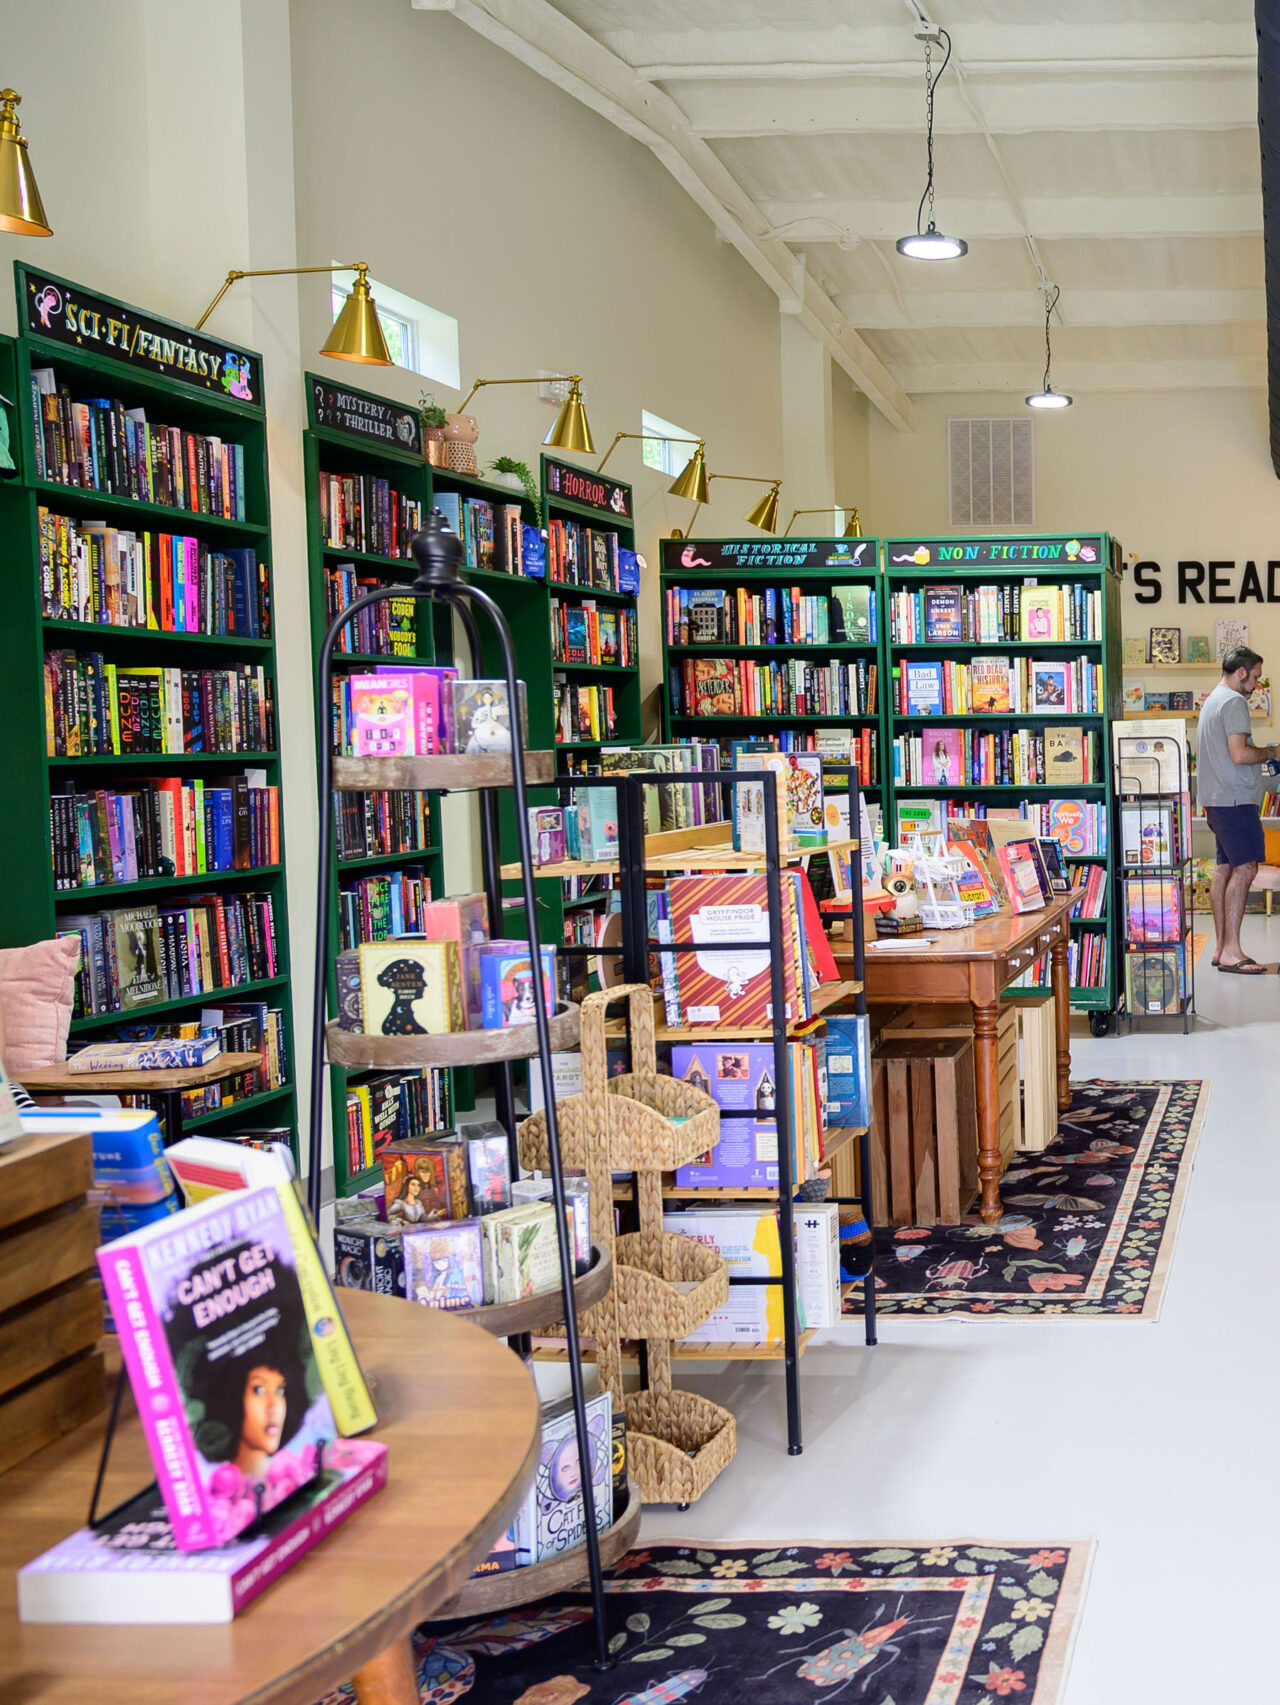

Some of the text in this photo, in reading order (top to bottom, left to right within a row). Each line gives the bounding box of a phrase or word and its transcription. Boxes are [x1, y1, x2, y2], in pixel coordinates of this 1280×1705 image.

[337, 393, 385, 419] MYSTERY
[344, 413, 394, 440] THRILLER
[562, 473, 607, 505] HORROR
[721, 543, 818, 556] HISTORICAL
[988, 544, 1062, 559] FICTION
[737, 555, 807, 566] FICTION
[42, 565, 51, 599] COREY
[61, 578, 69, 608] COREY
[392, 603, 414, 617] COBEN
[389, 630, 416, 643] NOBODY'S
[394, 643, 411, 655] FOOL
[913, 669, 932, 679] Bad
[973, 665, 985, 674] RED
[696, 678, 732, 693] PRETENDER
[915, 681, 935, 689] Law
[976, 675, 1005, 685] HISTORY
[119, 692, 132, 741] DUNE
[131, 697, 140, 731] DUNE
[139, 700, 149, 736] DUNE
[150, 698, 161, 739] DUNE
[963, 891, 986, 901] Library
[124, 911, 155, 922] MICHAEL
[372, 918, 387, 929] THE
[372, 930, 388, 942] TOP
[168, 935, 176, 971] HARROW
[179, 934, 187, 965] NONA
[89, 1059, 124, 1071] Wedding
[244, 1073, 254, 1093] ALL
[381, 1096, 394, 1111] KILLS
[374, 1109, 388, 1124] WELL
[379, 1112, 397, 1130] OTHERS
[235, 1192, 279, 1232] RYAN
[337, 1234, 365, 1248] MIDNIGHT
[340, 1243, 362, 1255] MAGIC
[177, 1240, 275, 1305] CAN'T GET
[192, 1267, 276, 1328] ENOUGH
[419, 1295, 470, 1309] Anime
[556, 1509, 604, 1551] SPIDES
